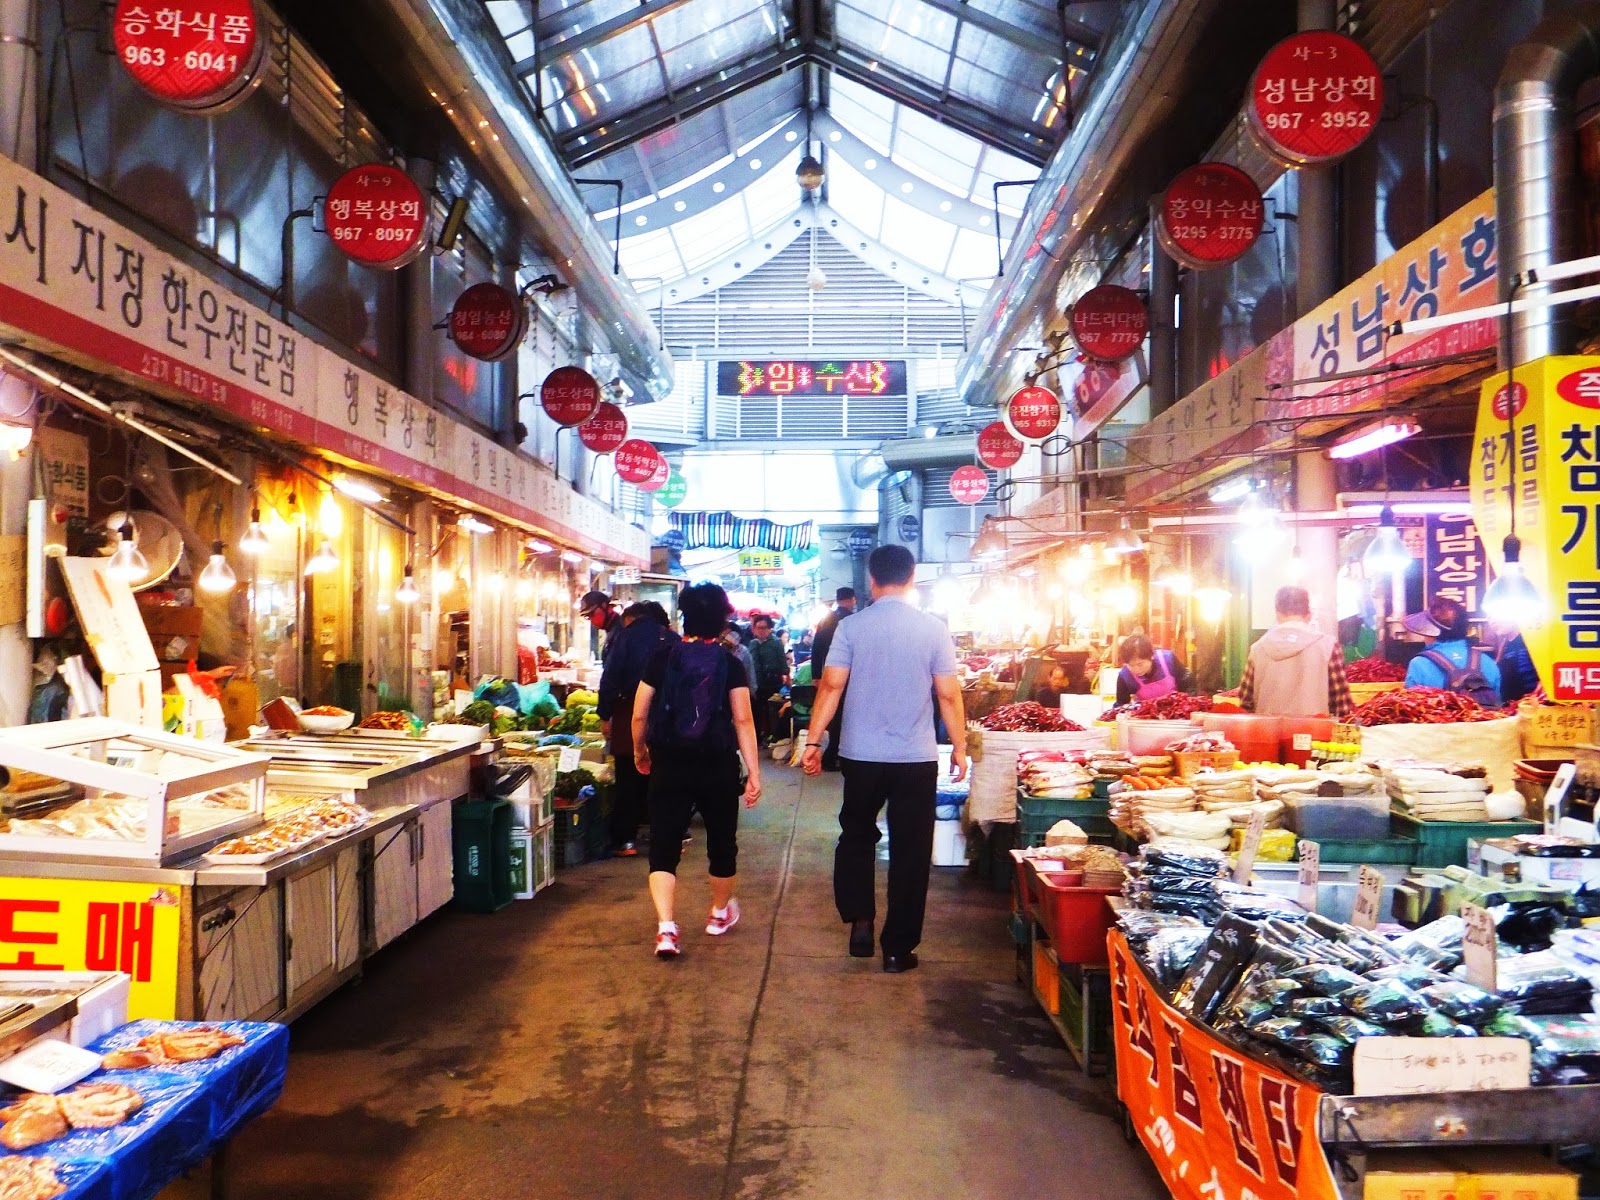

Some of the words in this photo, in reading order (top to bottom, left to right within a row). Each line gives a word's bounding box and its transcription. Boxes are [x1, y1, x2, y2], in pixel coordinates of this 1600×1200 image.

[121, 6, 252, 45] 승화식품
[1259, 75, 1377, 105] 성남상회
[330, 197, 420, 221] 행복상회
[1168, 198, 1260, 221] 홍익수산
[70, 218, 145, 329] 지정
[161, 265, 298, 398] 한우전문점
[1074, 312, 1147, 328] 나드리다방
[543, 387, 595, 400] 반도상회
[742, 555, 782, 568] 세모식품
[0, 898, 155, 983] 도매
